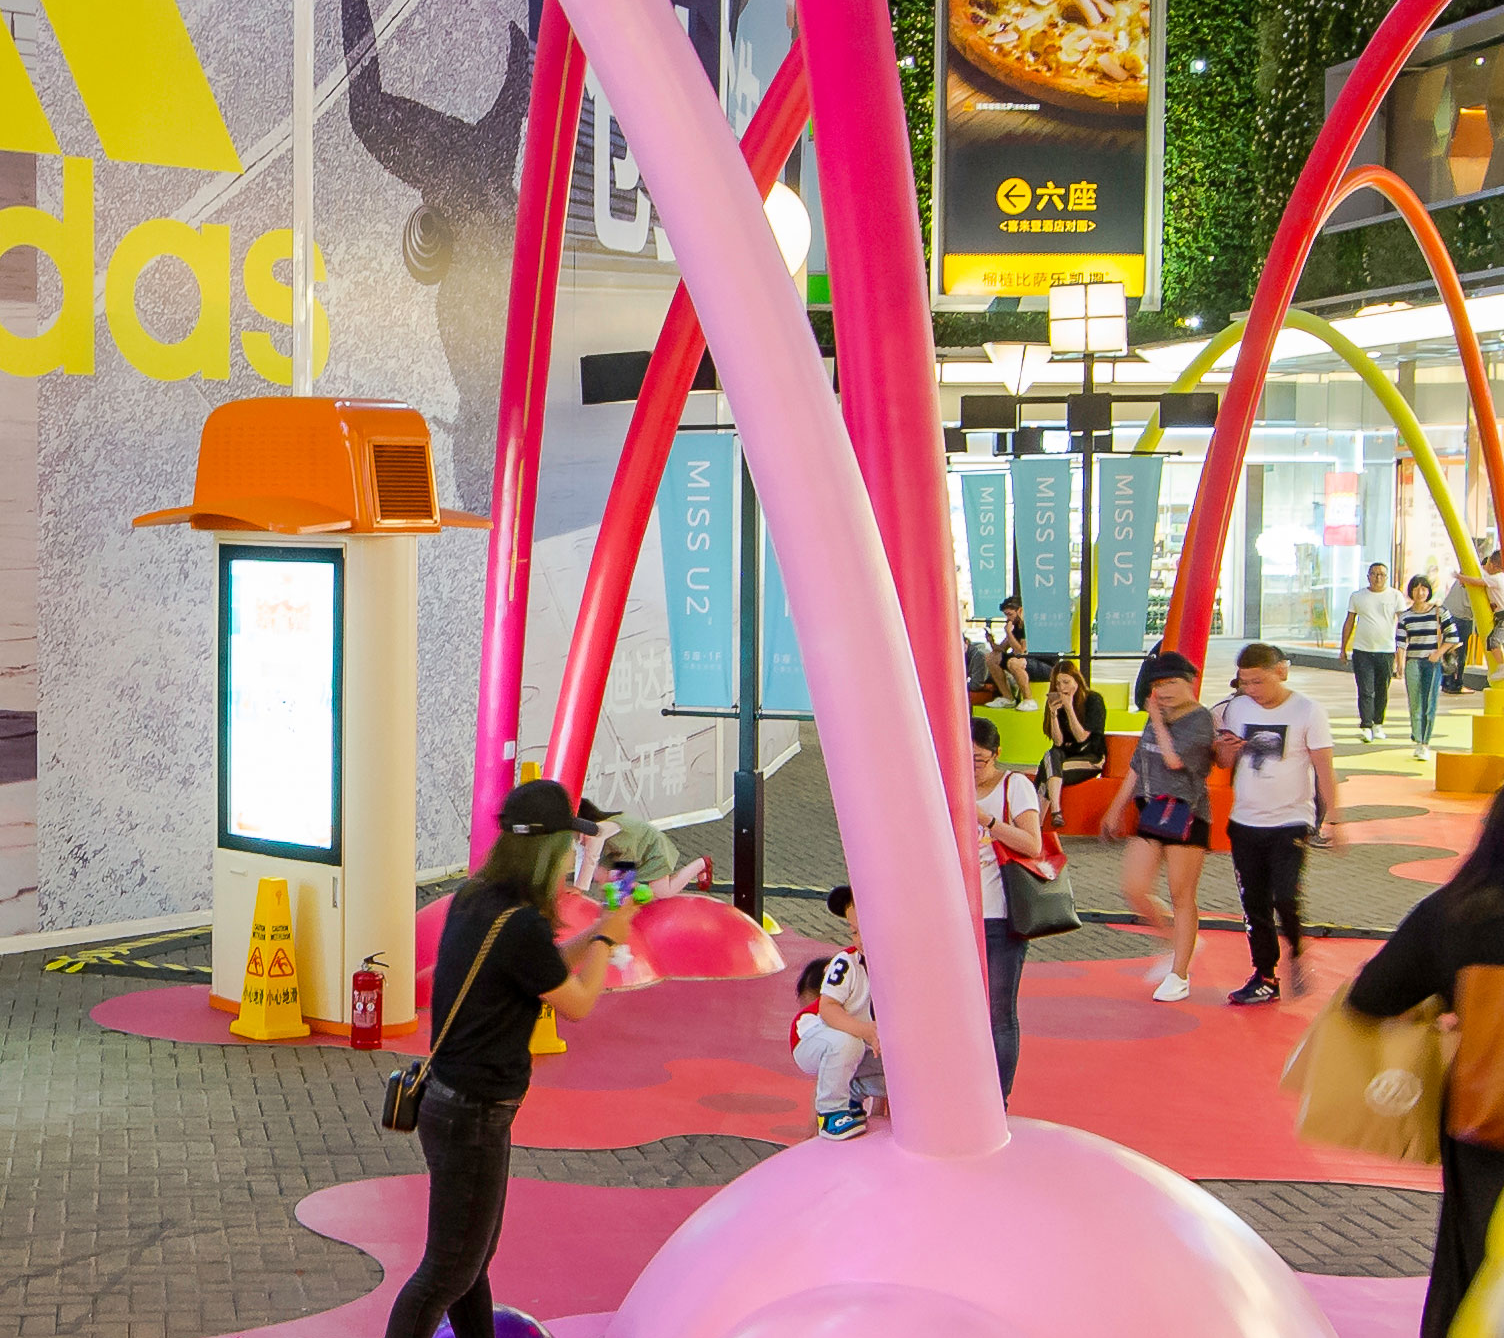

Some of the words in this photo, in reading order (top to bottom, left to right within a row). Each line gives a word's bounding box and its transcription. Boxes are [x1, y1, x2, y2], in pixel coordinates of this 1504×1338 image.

[1035, 180, 1098, 212] 六座
[686, 460, 711, 551] MISS
[979, 486, 995, 536] MISS
[1035, 476, 1055, 542] MISS
[1113, 474, 1134, 540] MISS
[979, 543, 995, 570] U2
[1035, 553, 1055, 588] U2
[1113, 551, 1134, 587] U2
[686, 567, 711, 616] U2
[826, 957, 850, 987] 3
